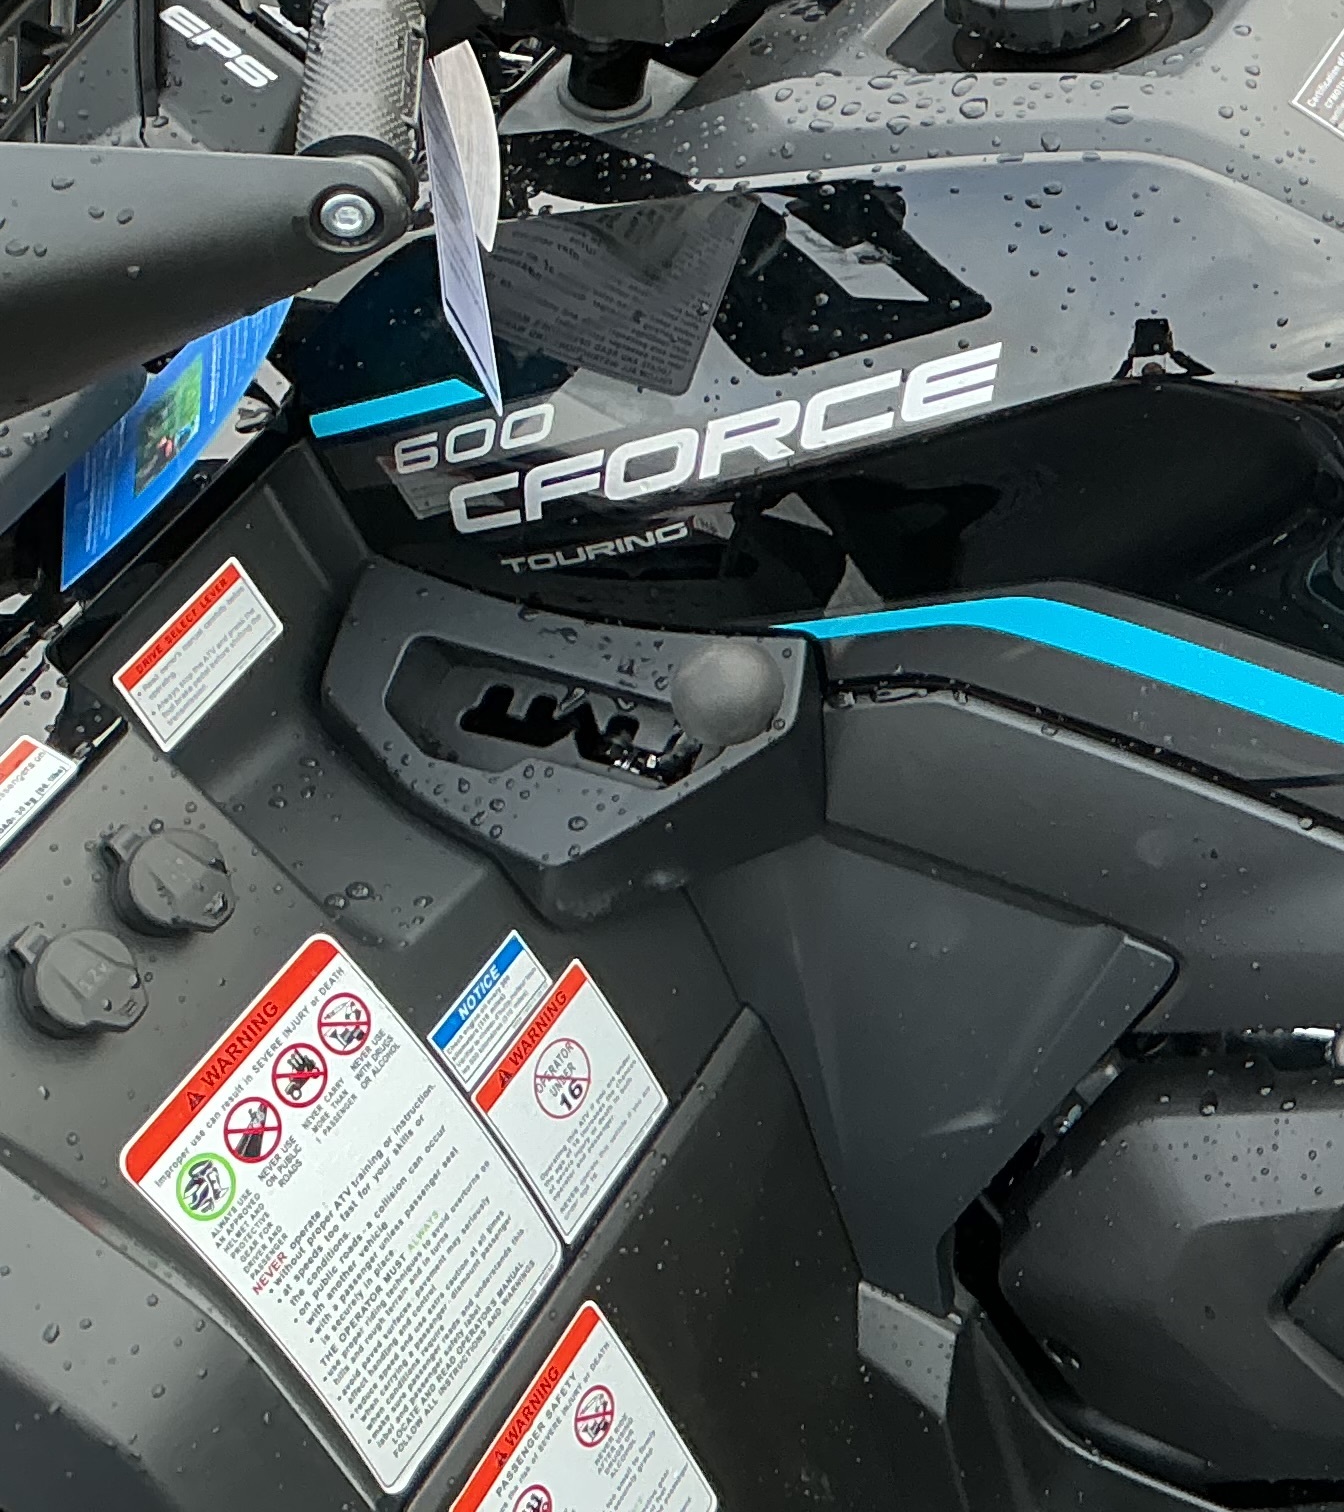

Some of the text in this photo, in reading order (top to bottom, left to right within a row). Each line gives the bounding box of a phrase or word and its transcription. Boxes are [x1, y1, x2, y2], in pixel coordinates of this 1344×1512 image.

[159, 4, 279, 88] EPS
[393, 401, 556, 475] 600
[448, 341, 1002, 535] CFORCE
[500, 519, 690, 575] TOURING
[136, 578, 227, 673] DRIVE SELECT LEVER
[0, 761, 38, 798] ssengers
[457, 965, 500, 1019] NOTICE
[200, 999, 279, 1089] WARNING
[350, 1029, 385, 1071] NEVER USE
[508, 989, 567, 1068] WARNING
[155, 966, 343, 1188] Improper use can result in SEVERE INJURY or DEATH
[354, 1034, 393, 1081] WITH DRUGS
[360, 1041, 400, 1089] OR ALCOHOL
[534, 1039, 574, 1093] OPERATOR
[548, 1060, 576, 1098] UNDER
[302, 1077, 344, 1129] NEVER CARRY
[311, 1089, 347, 1133] MORE THAN
[557, 1076, 584, 1114] 16
[258, 1136, 295, 1181] NEVER USE
[265, 1144, 301, 1188] ON PUBLIC
[272, 1080, 435, 1286] without proper ATV training or instruction.
[278, 1158, 302, 1187] ROADS
[210, 1188, 251, 1237] ALWAYS USE
[215, 1192, 260, 1248] AN APPROVED
[223, 1202, 264, 1253] HELMET AND
[282, 1114, 424, 1296] at speeds too fast for your skills or
[298, 1125, 446, 1316] on public roads a collision can occur
[230, 1211, 269, 1259] PROTECTIVE
[239, 1221, 273, 1262] GEAR FOR
[243, 1224, 282, 1273] DRIVER AND
[249, 1233, 288, 1279] PASSENGER
[252, 1209, 322, 1294] NEVER operate
[289, 1228, 350, 1306] the conditions.
[320, 1210, 438, 1367] THE OPERATOR MUST ALWAYS
[504, 1364, 559, 1448] WARNING
[508, 1341, 609, 1500] the risk of SEVERE INJURY or DEATH
[495, 1371, 576, 1497] PASSENGER SAFETY
